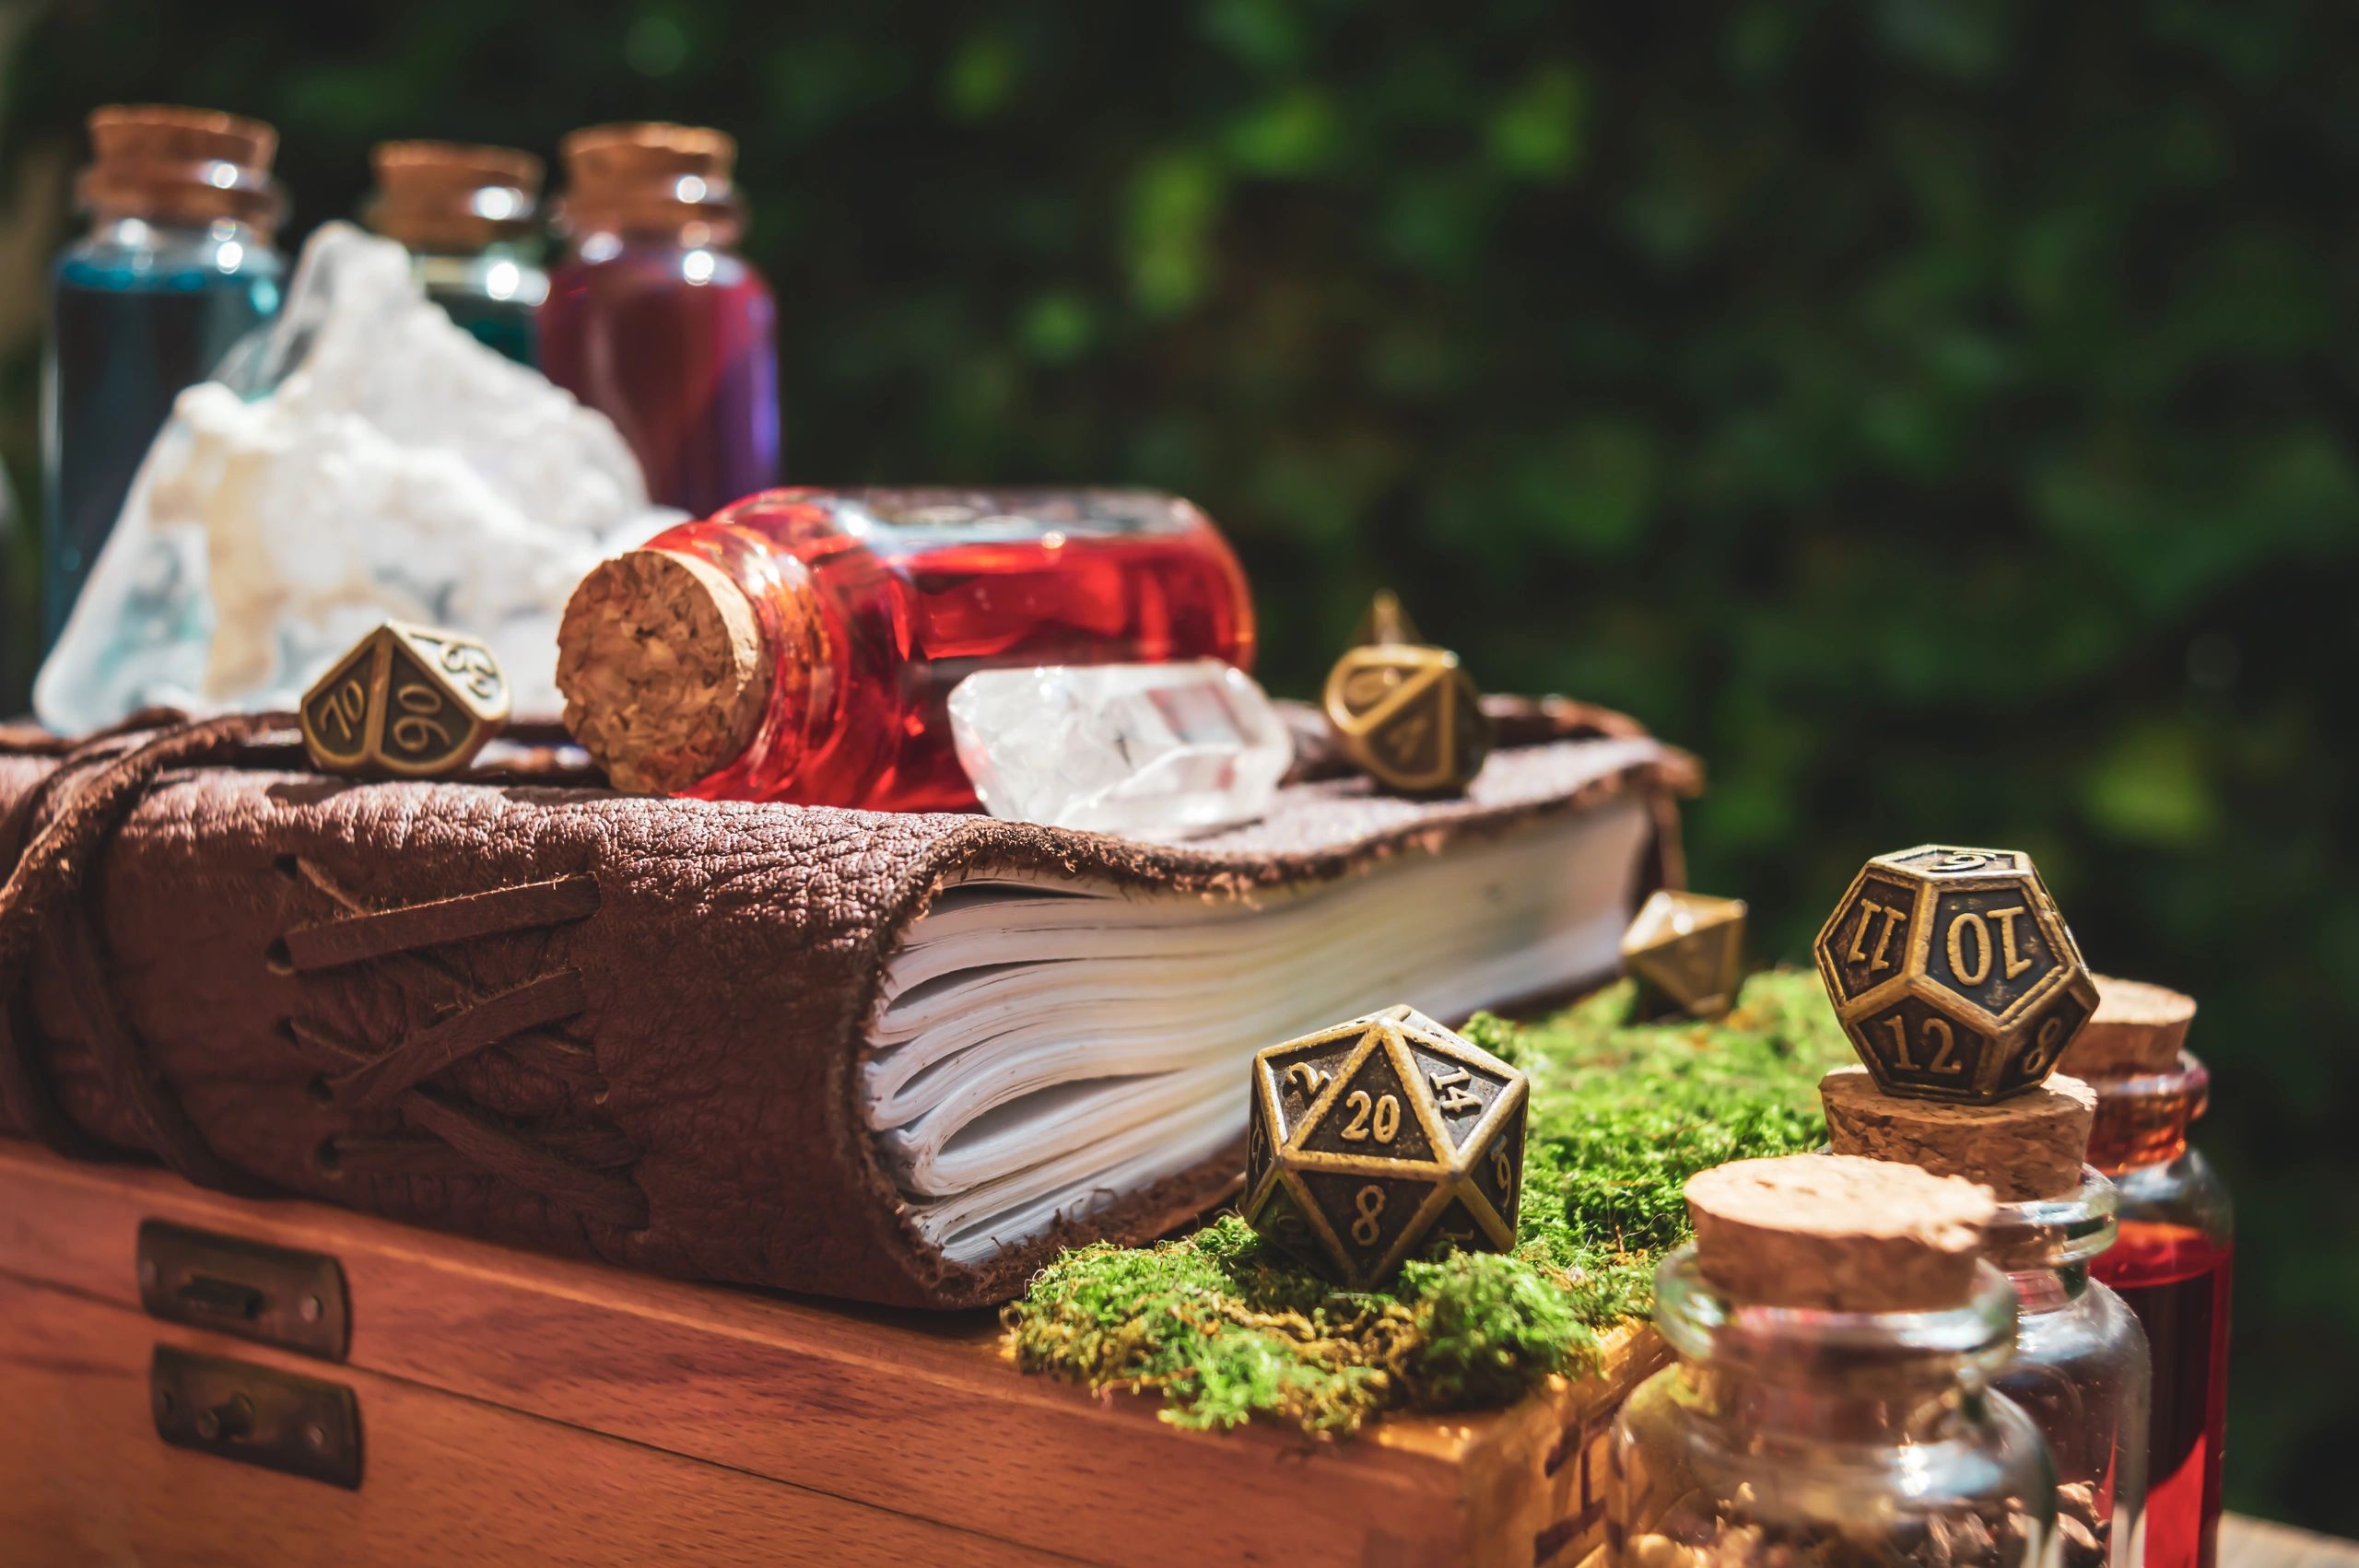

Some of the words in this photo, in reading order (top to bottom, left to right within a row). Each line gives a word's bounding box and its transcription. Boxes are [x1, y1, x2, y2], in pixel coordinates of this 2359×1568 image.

[317, 677, 366, 742] 70
[392, 684, 452, 753] 90
[1847, 898, 1907, 972] 11
[1945, 906, 2033, 987] 10
[1884, 1014, 1962, 1075] 12
[2024, 1017, 2062, 1075] 8
[1285, 1061, 1332, 1095] 2
[1429, 1066, 1483, 1113] 14
[1341, 1090, 1402, 1144] 20
[1352, 1184, 1386, 1246] 8
